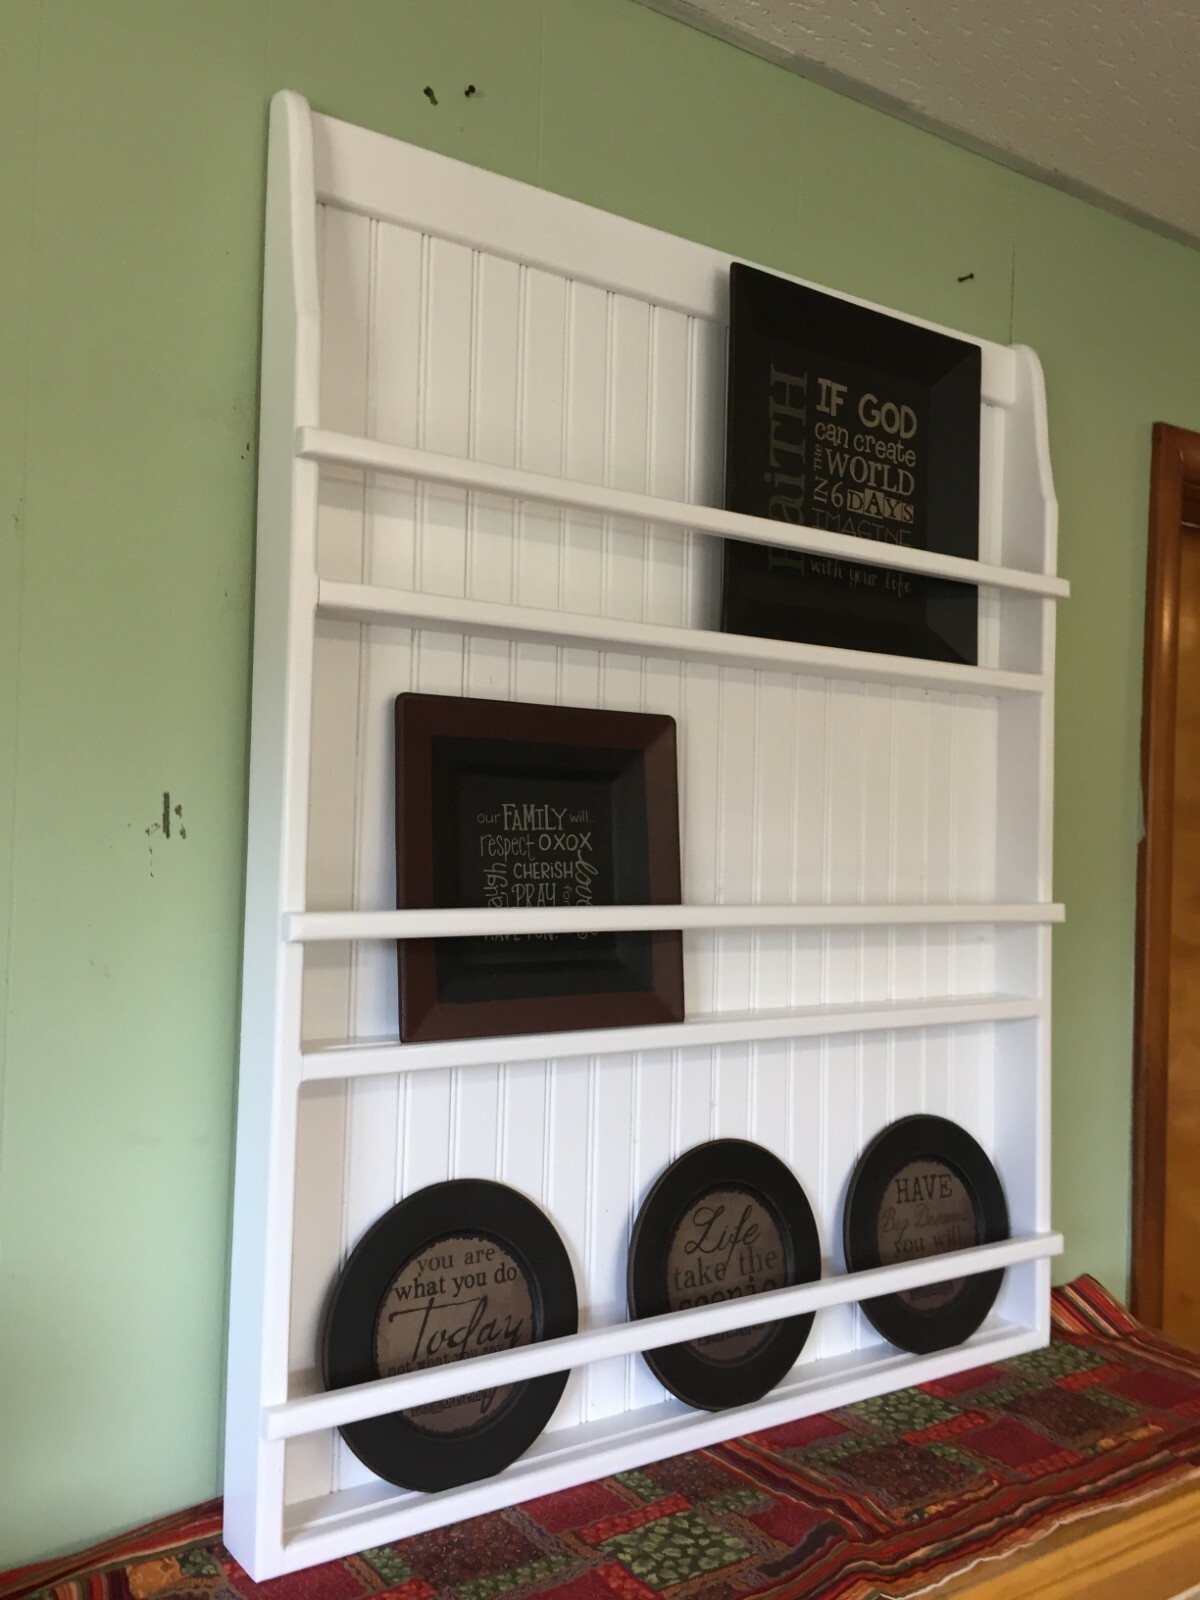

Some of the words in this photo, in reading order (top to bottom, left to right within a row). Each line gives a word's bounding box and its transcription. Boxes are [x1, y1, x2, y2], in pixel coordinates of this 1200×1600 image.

[816, 376, 848, 417] IF
[858, 392, 918, 440] GOD
[815, 421, 849, 449] can
[853, 433, 917, 468] create
[813, 475, 829, 504] IN
[830, 480, 844, 509] 6
[846, 486, 914, 524] DAYS
[811, 506, 913, 548] IMAGINE
[809, 556, 843, 580] with
[477, 813, 501, 824] our
[502, 803, 568, 831] FAMILY
[480, 833, 536, 863] respect
[483, 861, 509, 908] augh
[511, 882, 557, 908] PRAY
[895, 1174, 953, 1205] HAVE
[684, 1203, 761, 1276] Life
[880, 1206, 910, 1236] Big
[893, 1237, 925, 1259] you
[932, 1225, 963, 1249] will
[416, 1253, 454, 1275] you
[464, 1247, 496, 1266] are
[673, 1257, 727, 1292] take
[739, 1246, 778, 1277] the
[394, 1277, 446, 1302] what
[452, 1270, 488, 1298] you
[494, 1262, 519, 1285] do
[388, 1294, 524, 1363] Today
[387, 1361, 413, 1377] not
[417, 1354, 450, 1369] what
